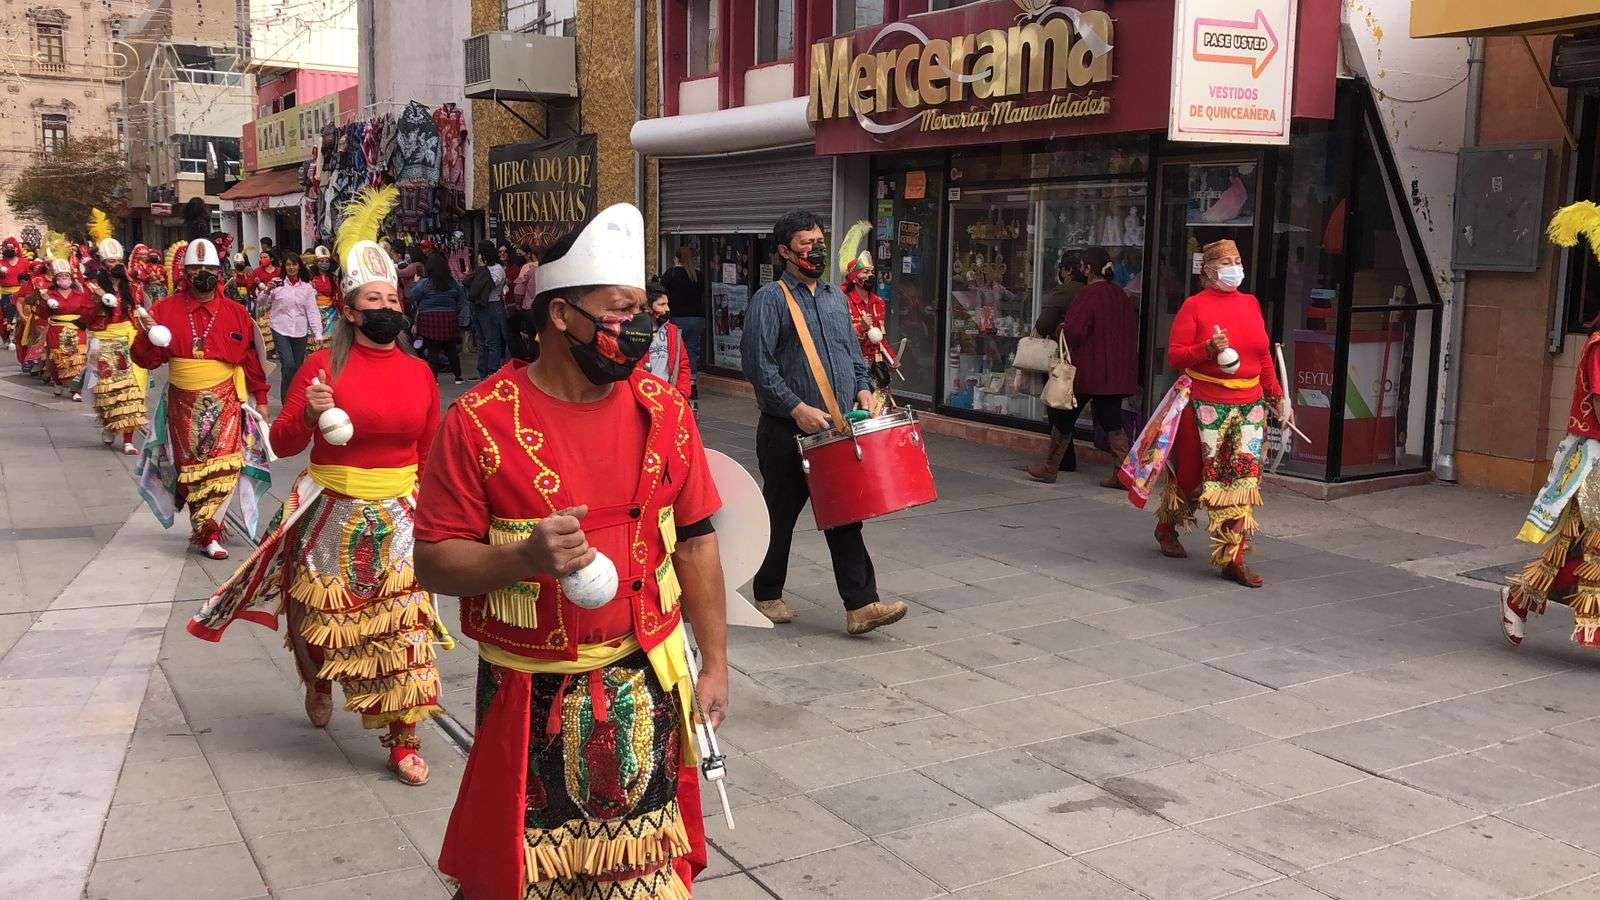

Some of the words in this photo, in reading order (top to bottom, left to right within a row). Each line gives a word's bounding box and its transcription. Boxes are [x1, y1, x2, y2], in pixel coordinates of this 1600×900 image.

[1204, 32, 1231, 48] PASE
[1233, 35, 1268, 51] USTED
[808, 10, 1115, 121] Mercerama
[1209, 86, 1258, 100] VESTIDOS
[990, 90, 1110, 126] Manualidades
[1190, 104, 1203, 118] DE
[1206, 104, 1276, 121] QUINCEAÑERA
[493, 157, 562, 189] MERCADO
[568, 155, 592, 187] DE
